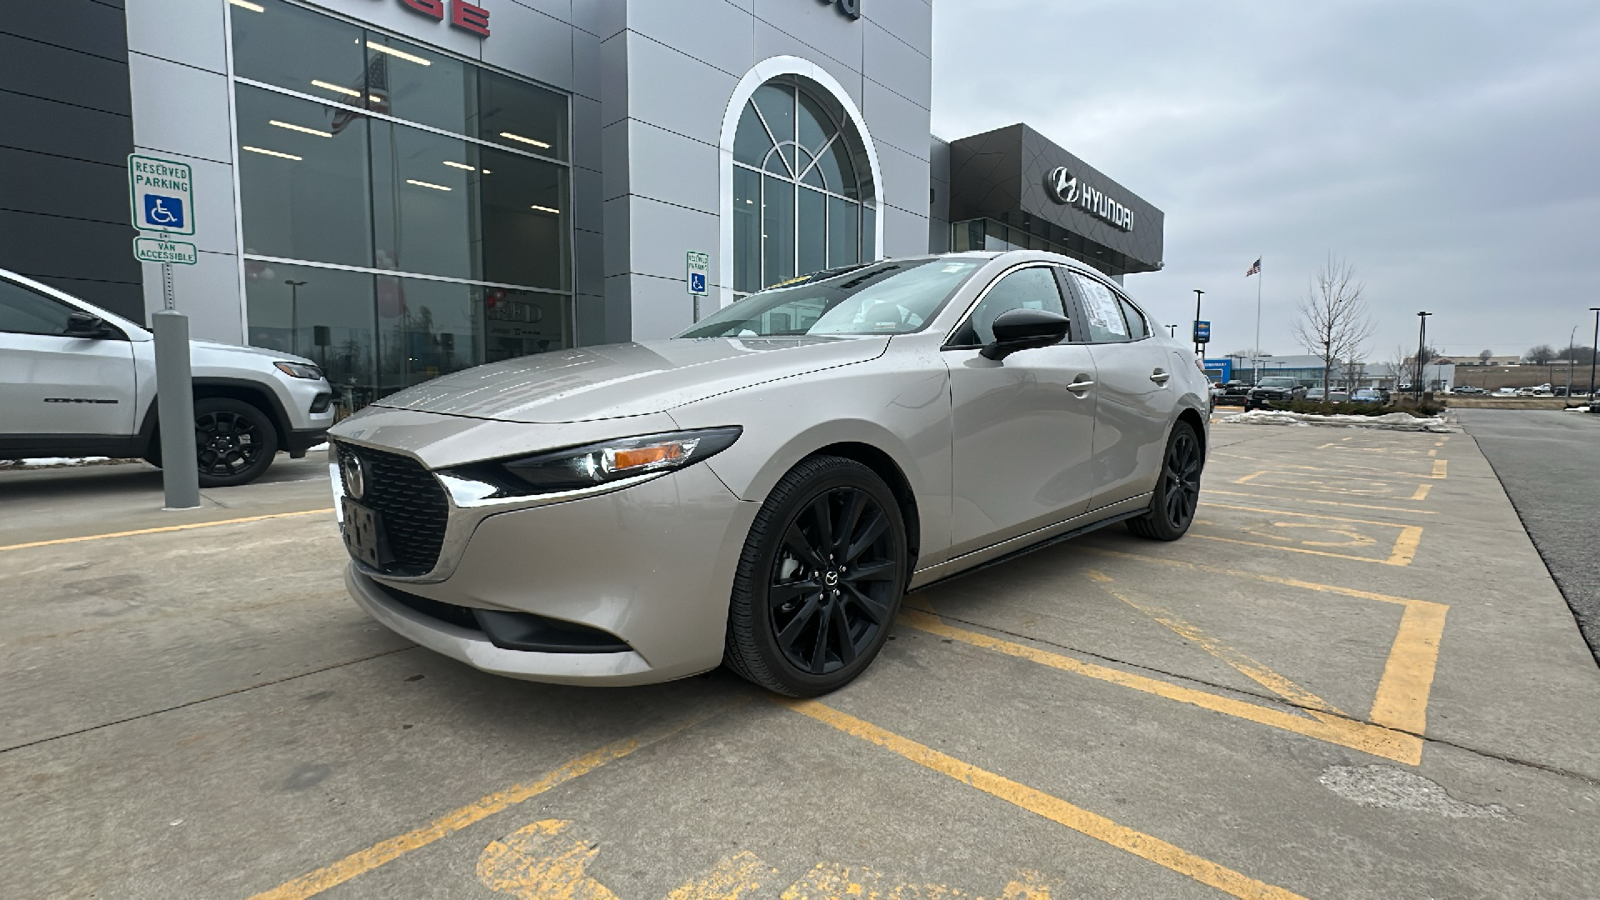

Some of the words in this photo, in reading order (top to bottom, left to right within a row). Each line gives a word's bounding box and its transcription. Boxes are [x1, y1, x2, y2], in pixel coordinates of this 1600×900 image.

[135, 161, 187, 179] RESERVED
[136, 175, 188, 192] PARKING
[1081, 183, 1134, 231] HYUNDAI
[140, 250, 194, 261] ACCESSIBLE
[158, 243, 176, 251] VAN
